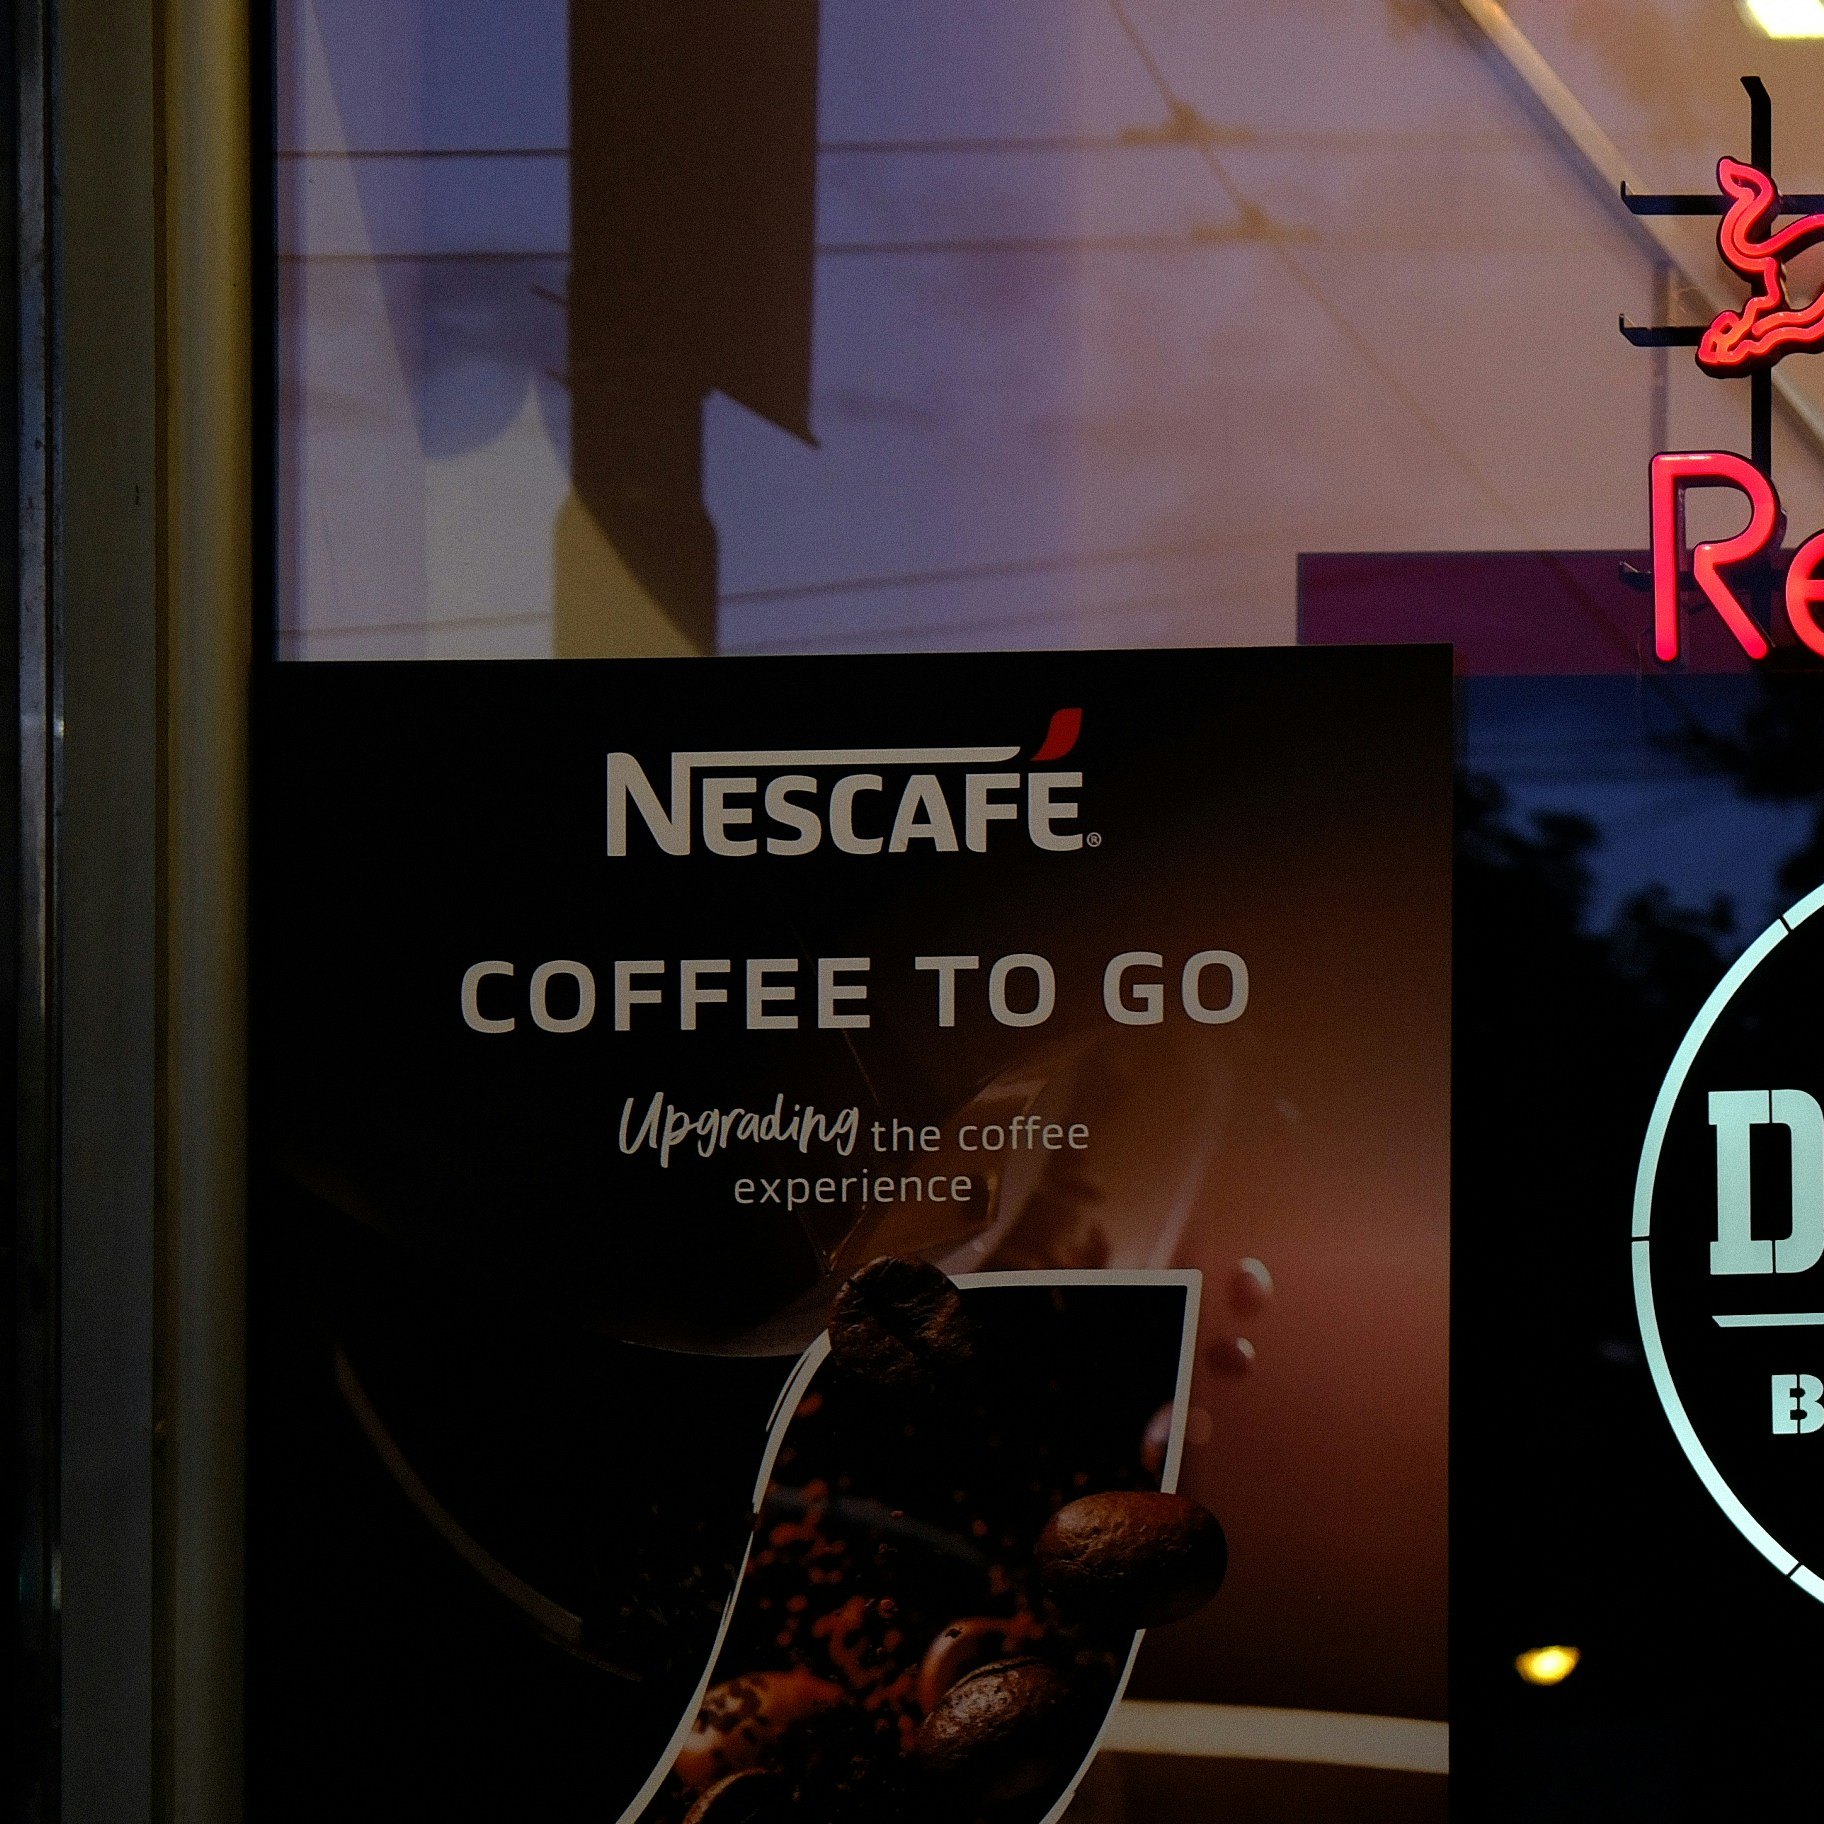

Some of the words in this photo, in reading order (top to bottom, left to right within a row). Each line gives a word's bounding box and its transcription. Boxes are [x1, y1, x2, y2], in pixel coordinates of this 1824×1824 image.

[606, 707, 1084, 857] NESCAFÉ
[459, 957, 871, 1034] COFFEE
[914, 952, 1057, 1029] TO
[1102, 949, 1251, 1026] GO
[617, 1091, 860, 1168] Upgrading
[871, 1117, 941, 1154] the
[957, 1115, 1091, 1152] coffee
[733, 1168, 974, 1211] experience
